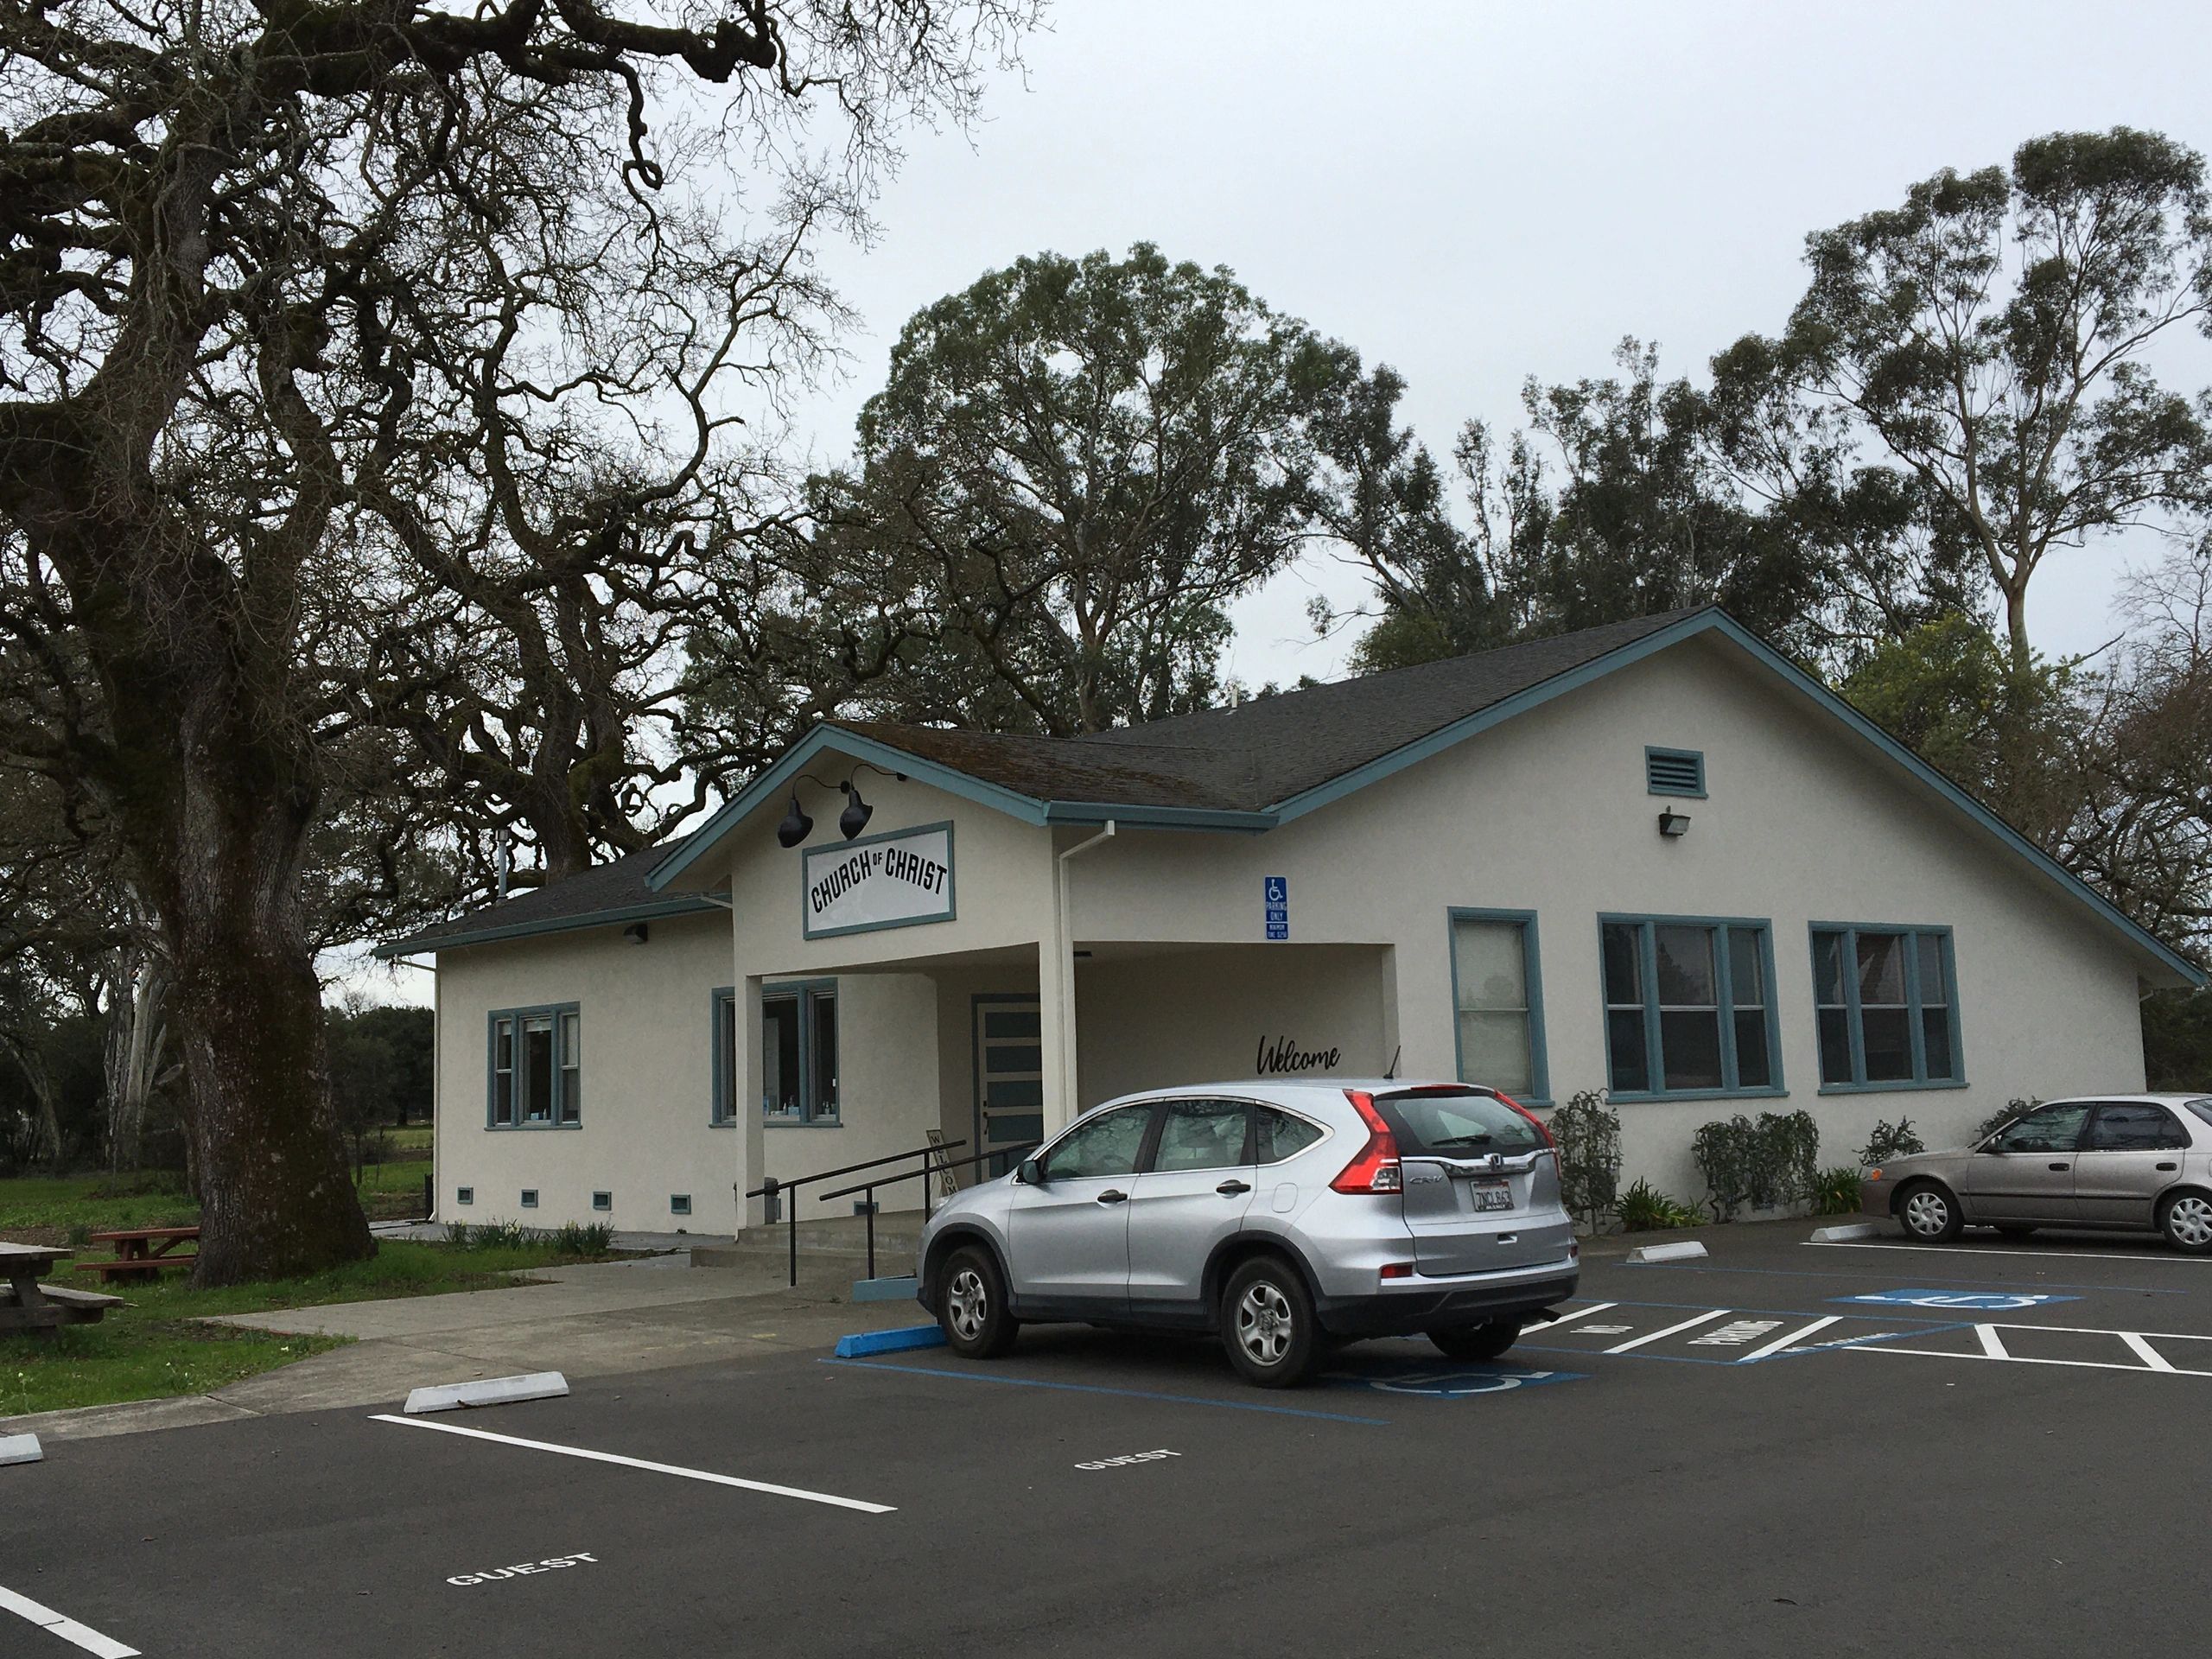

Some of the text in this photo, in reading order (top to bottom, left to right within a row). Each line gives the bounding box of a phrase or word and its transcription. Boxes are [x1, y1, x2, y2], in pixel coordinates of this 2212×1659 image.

[810, 848, 948, 913] CHURCH OF CHRIST
[1256, 1035, 1341, 1075] Welcome
[1074, 1449, 1182, 1470] GUEST
[446, 1553, 599, 1586] GUEST
